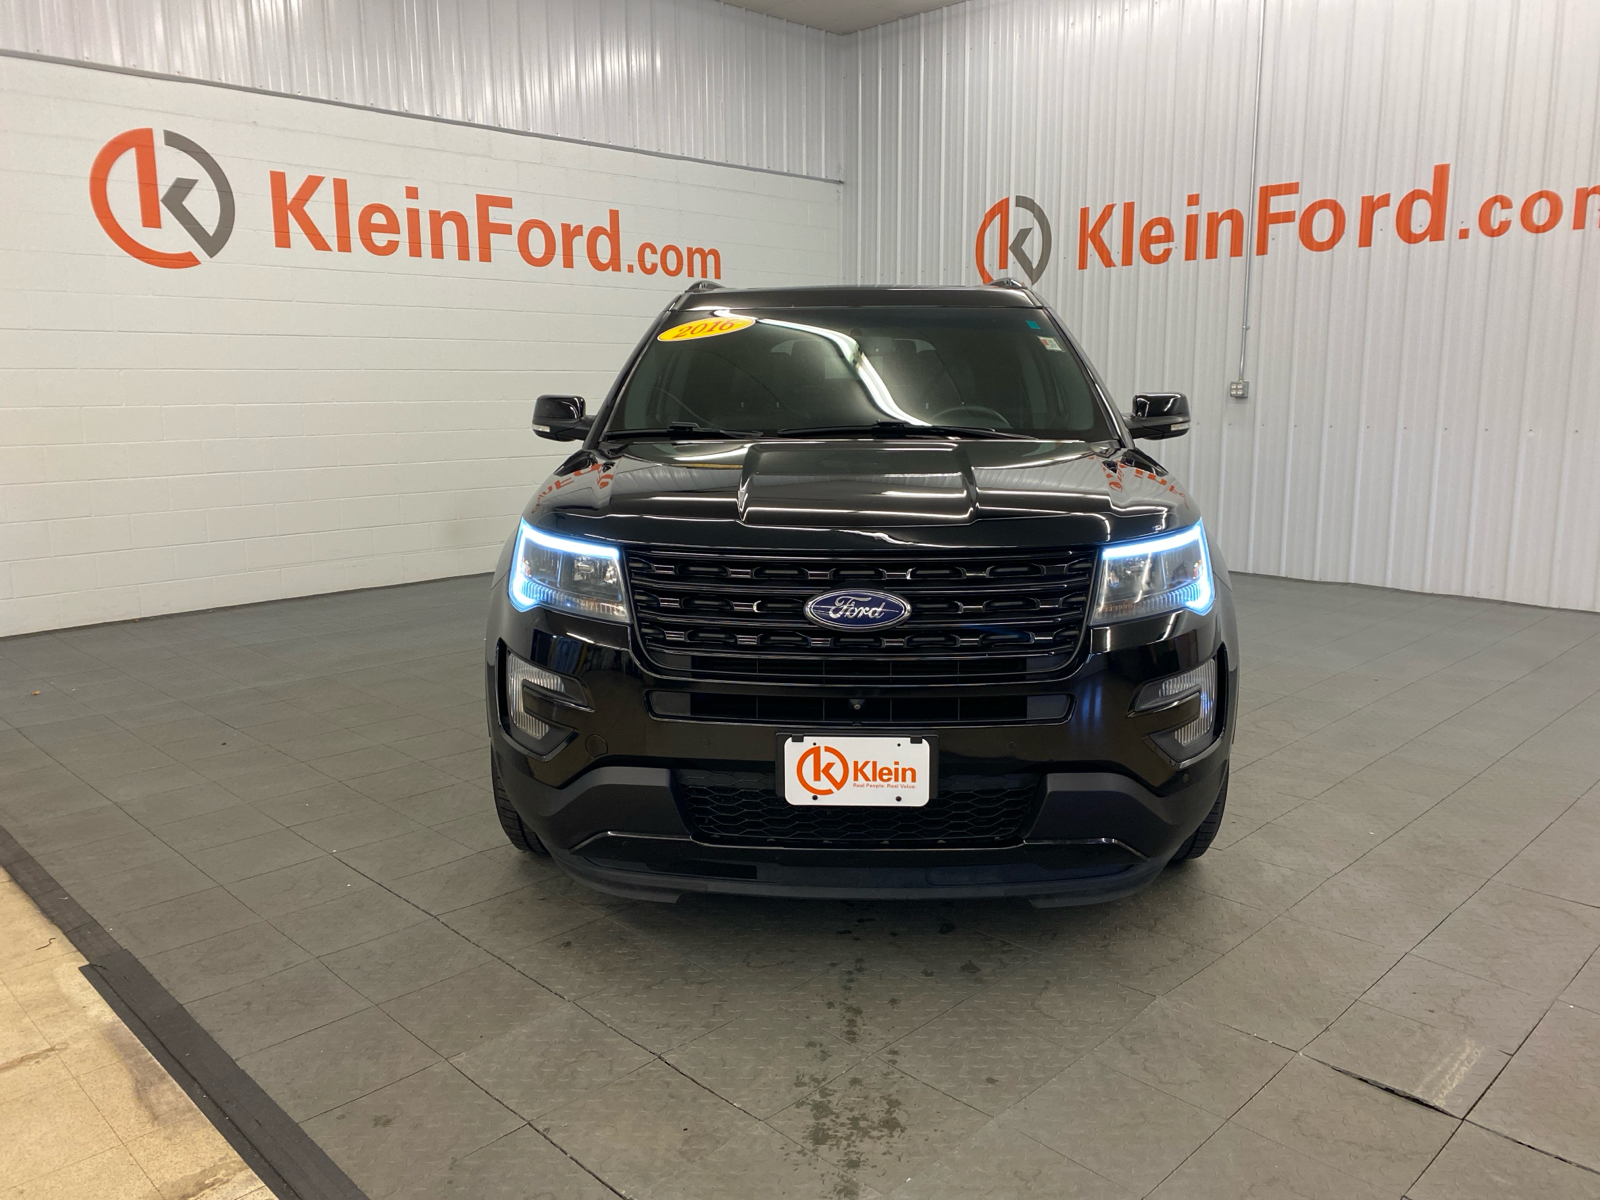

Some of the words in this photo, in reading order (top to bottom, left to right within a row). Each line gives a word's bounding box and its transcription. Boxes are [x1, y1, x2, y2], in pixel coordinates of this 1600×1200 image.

[269, 170, 722, 279] KleinFord.com
[672, 319, 735, 339] 2016
[829, 595, 885, 619] Ford
[853, 760, 917, 783] Klein
